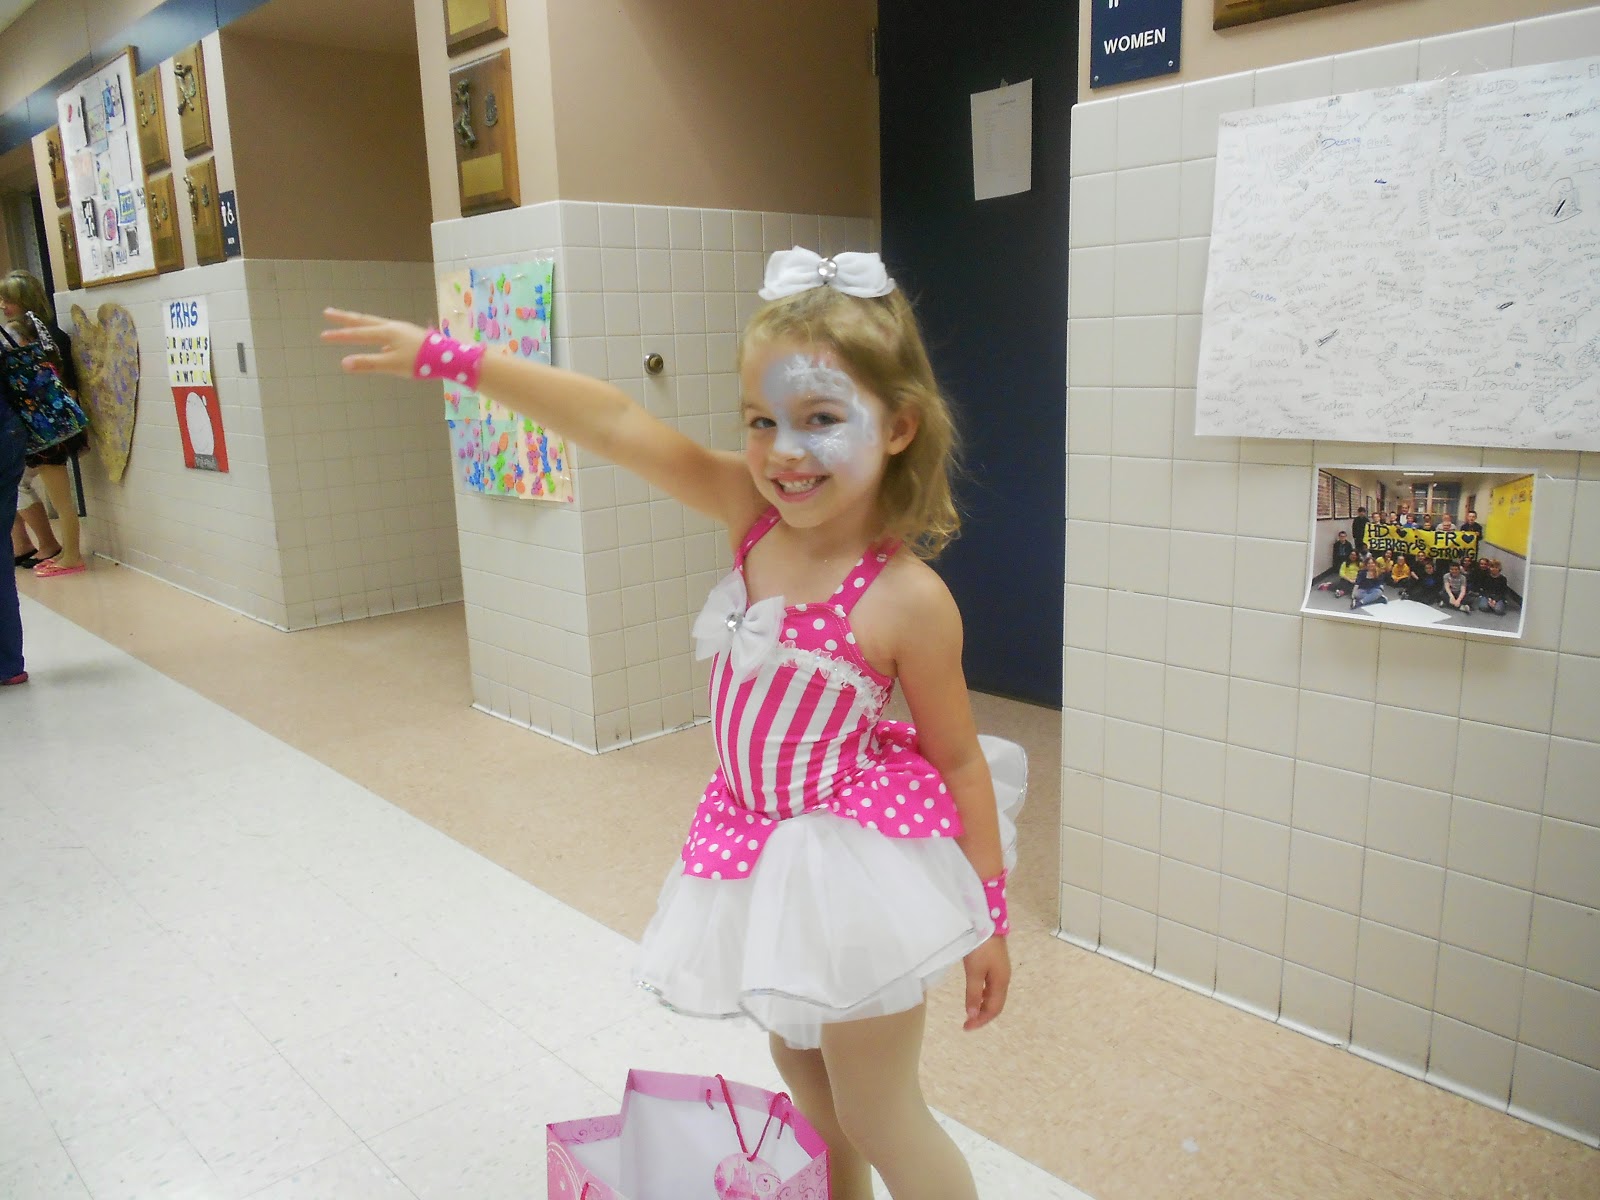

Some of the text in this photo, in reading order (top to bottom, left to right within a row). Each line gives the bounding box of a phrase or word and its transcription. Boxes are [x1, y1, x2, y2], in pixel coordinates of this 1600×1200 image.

[1103, 27, 1166, 55] WOMEN
[170, 302, 198, 328] FRHS
[1368, 524, 1390, 538] HD
[1434, 531, 1460, 547] FR
[1428, 547, 1475, 560] STRONG
